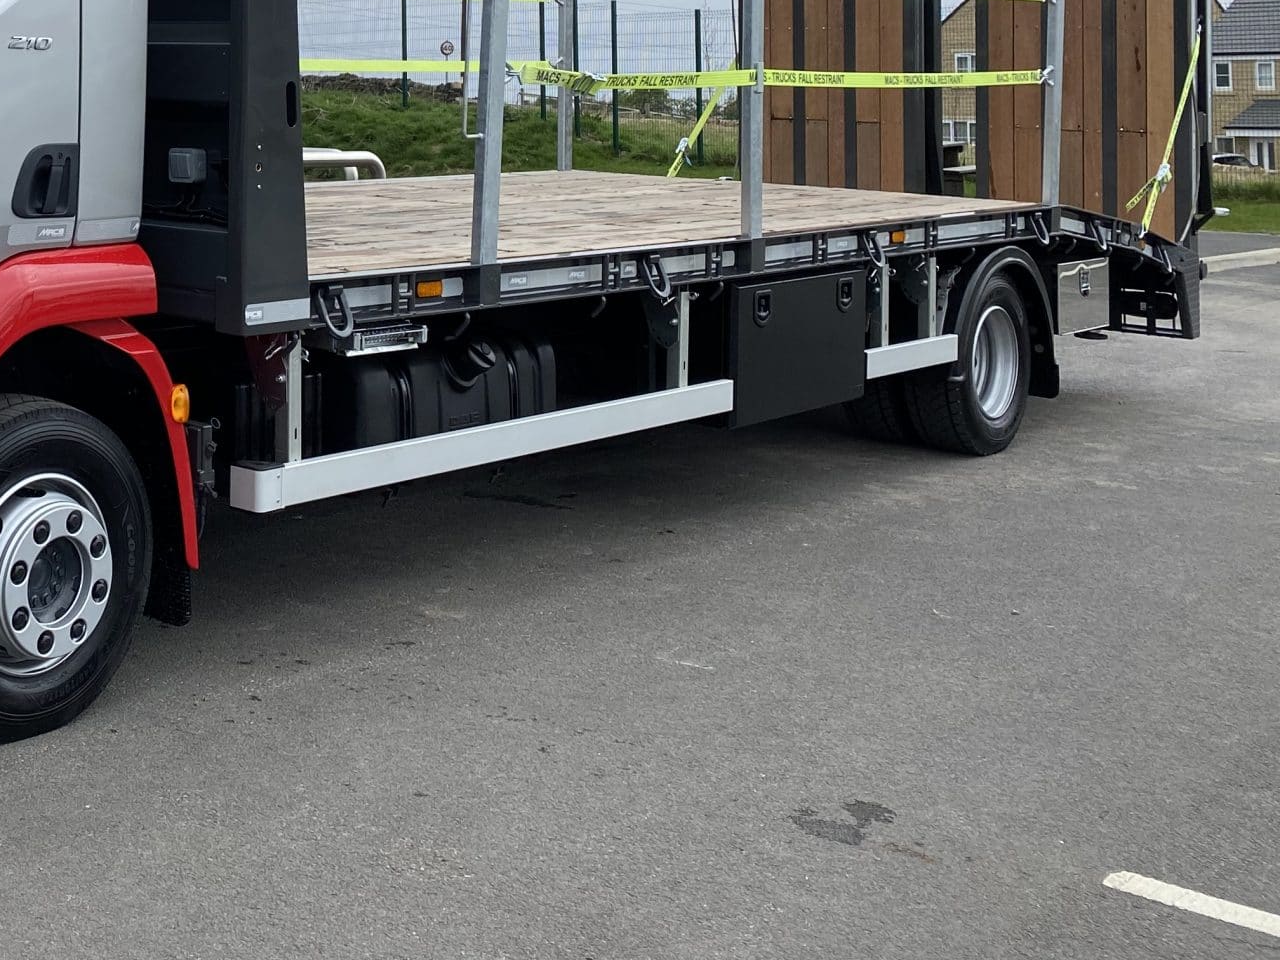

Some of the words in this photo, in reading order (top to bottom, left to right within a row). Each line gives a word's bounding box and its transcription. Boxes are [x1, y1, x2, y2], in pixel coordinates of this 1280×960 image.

[7, 36, 53, 51] 210
[536, 69, 562, 84] MACS
[606, 75, 637, 87] TRUCKS
[639, 76, 658, 87] FALL
[659, 74, 701, 86] RESTRAINT
[772, 72, 796, 83] TRUCKS
[798, 73, 813, 84] FALL
[814, 74, 845, 85] RESTRAINT
